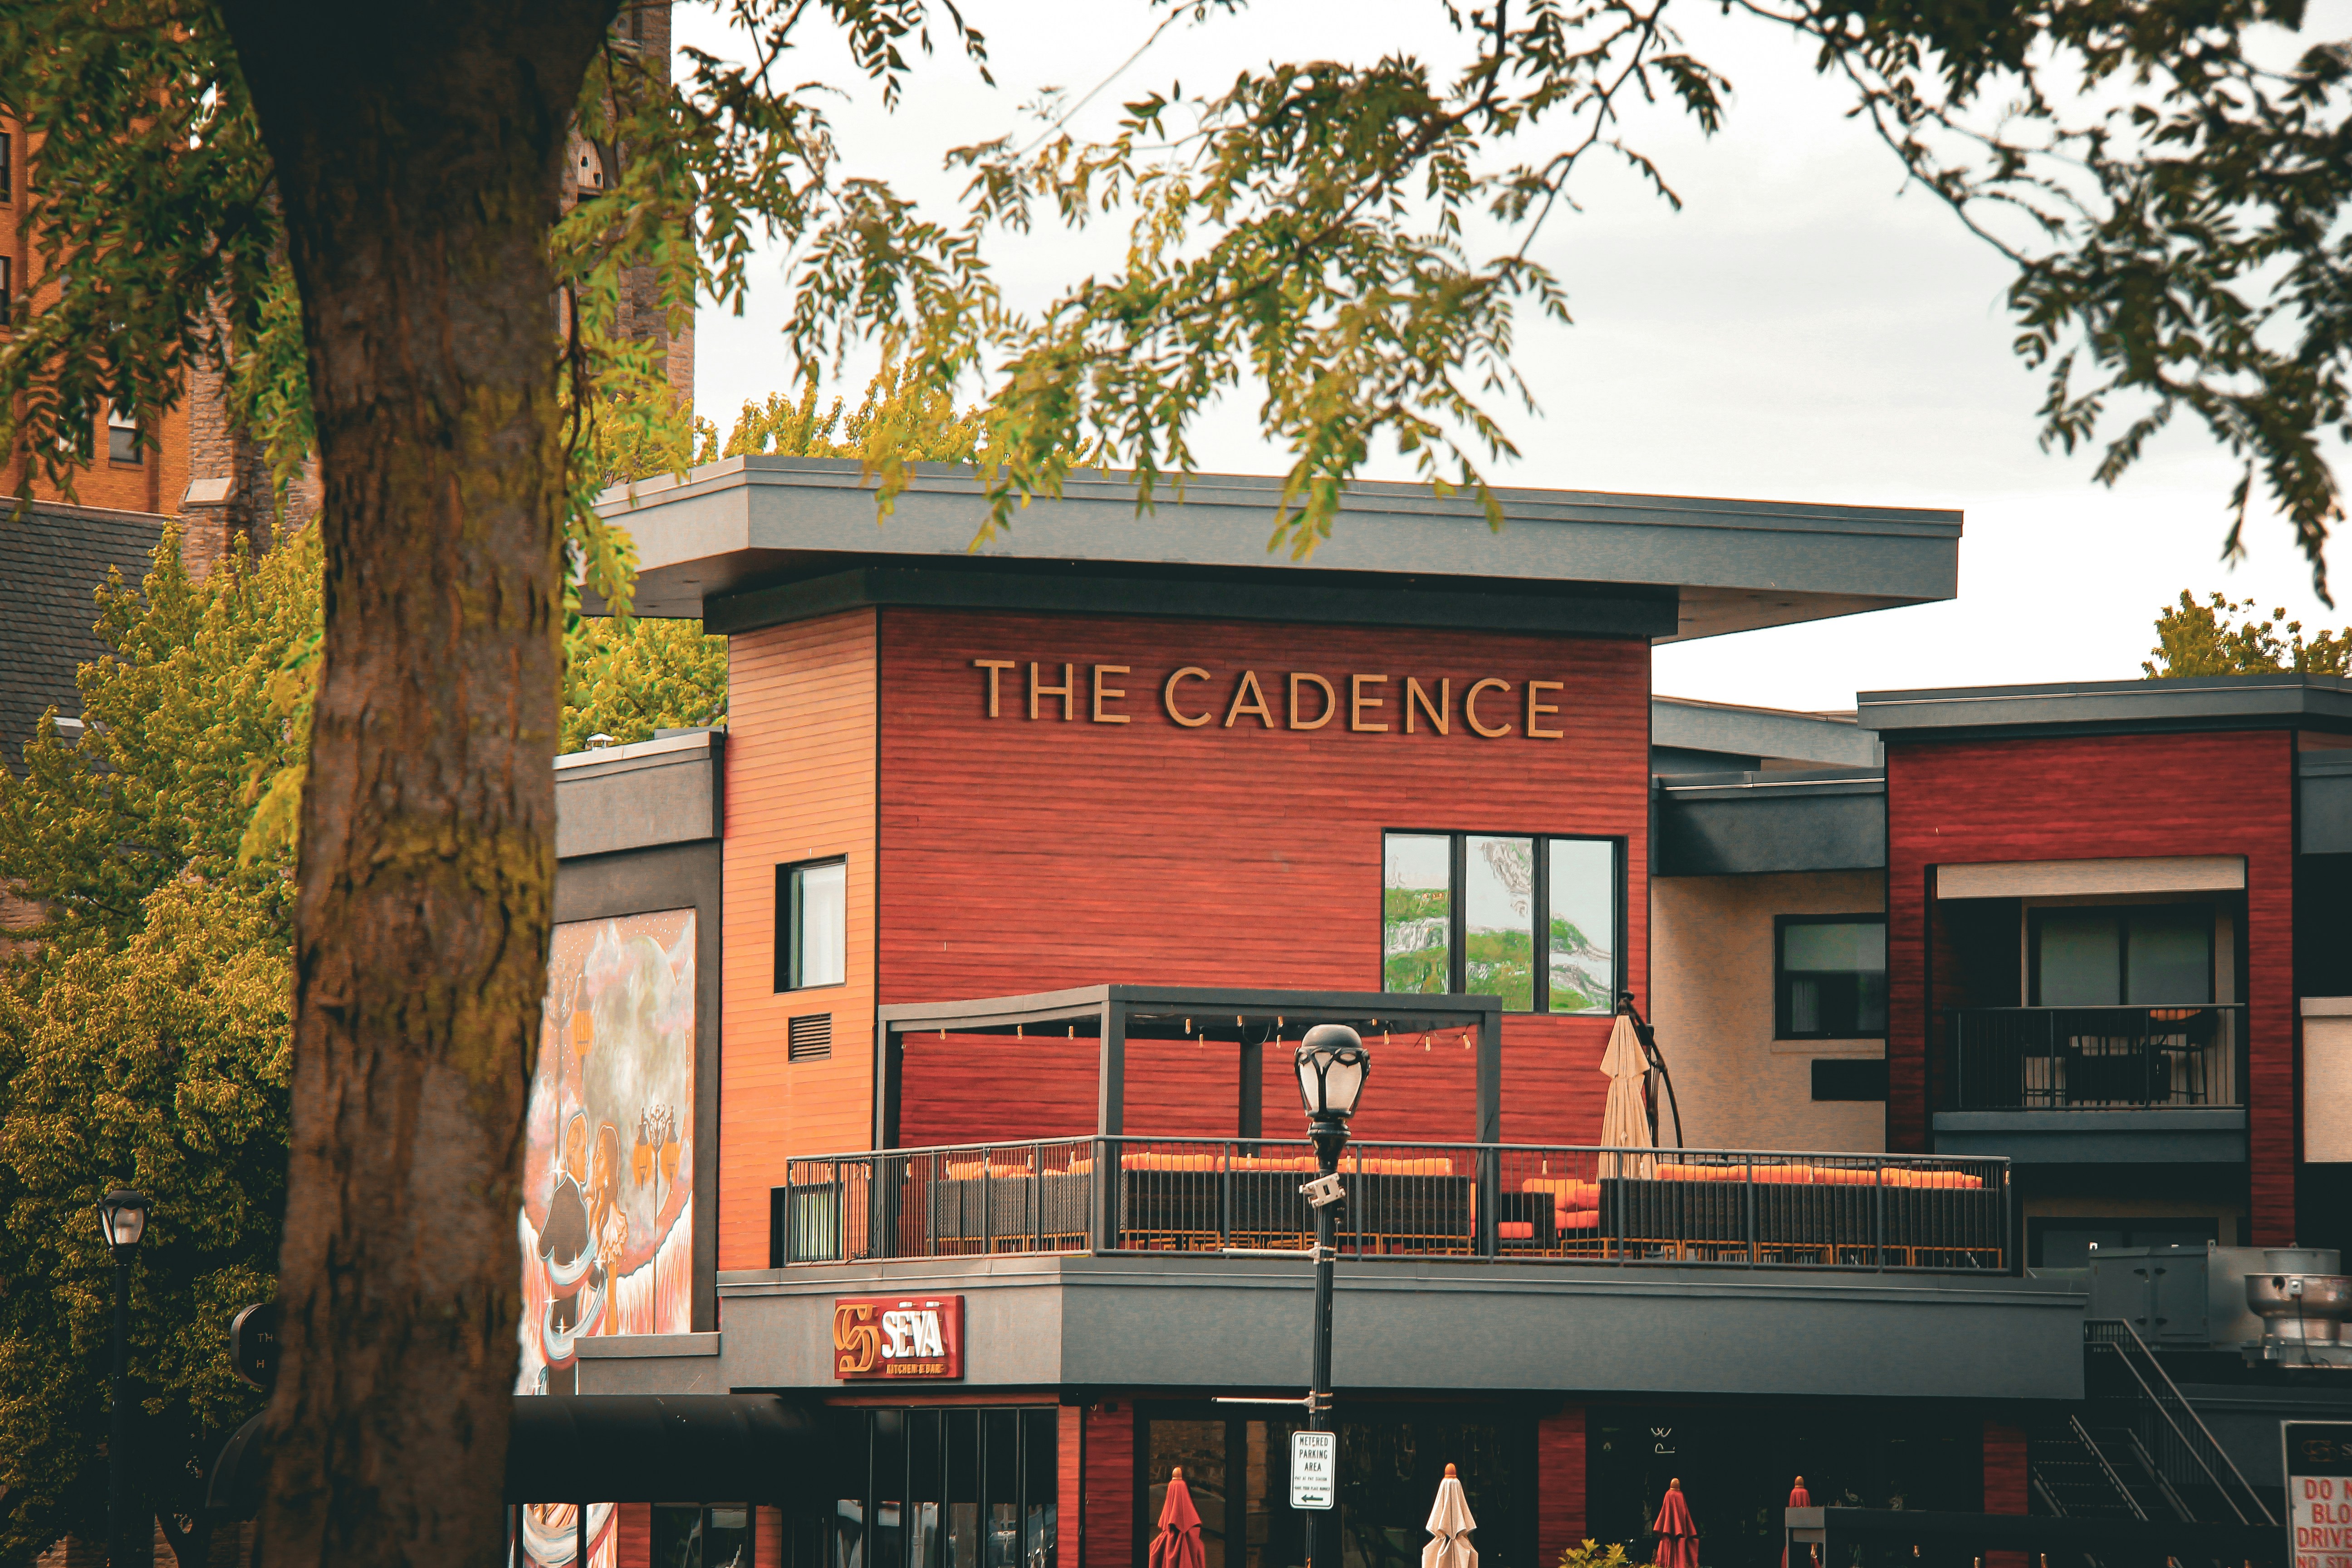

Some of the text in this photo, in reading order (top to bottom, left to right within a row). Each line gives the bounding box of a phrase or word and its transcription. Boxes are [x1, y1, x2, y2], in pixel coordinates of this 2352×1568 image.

[974, 659, 1564, 738] THE CADENCE
[257, 1333, 273, 1343] TH
[886, 1364, 918, 1374] KITCHEN
[926, 1363, 944, 1374] BAR
[1299, 1436, 1328, 1446] METERED
[1299, 1449, 1328, 1460] PARKING
[1304, 1462, 1322, 1471] AREA
[2305, 1478, 2334, 1500] DO
[2312, 1503, 2352, 1524] BLO
